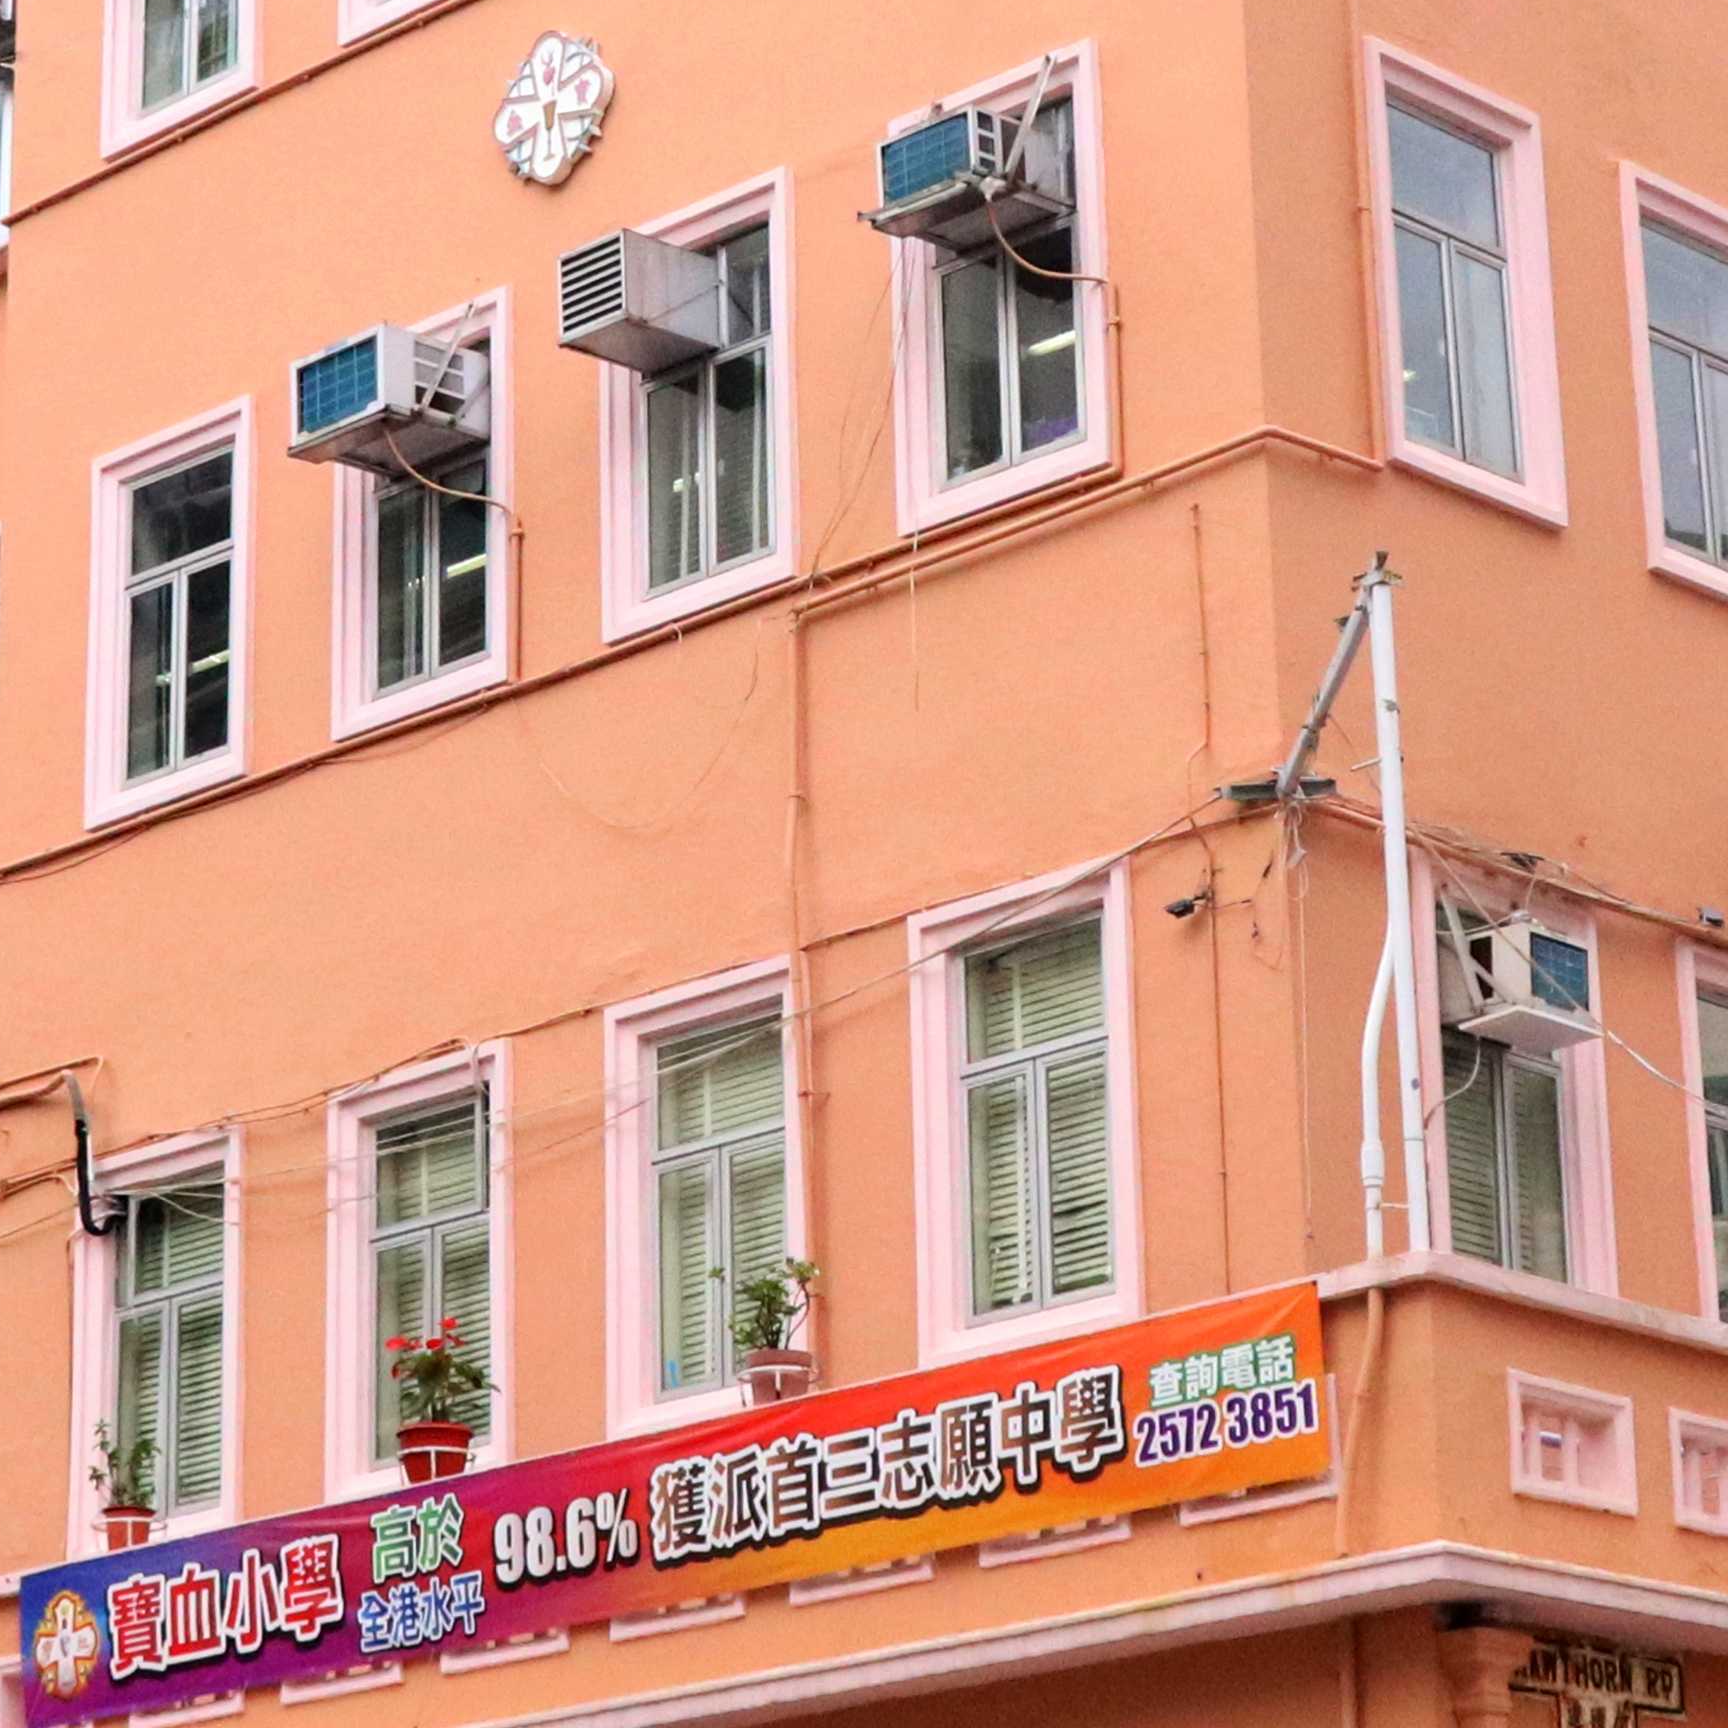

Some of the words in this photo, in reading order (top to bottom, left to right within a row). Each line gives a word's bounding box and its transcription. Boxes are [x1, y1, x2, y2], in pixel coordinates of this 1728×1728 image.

[1149, 1334, 1296, 1408] 查詢電話
[1136, 1403, 1220, 1463] 2572
[1225, 1382, 1316, 1444] 3851
[493, 1487, 639, 1585] 98.6%
[653, 1367, 1122, 1558] 獲派首三志願中學
[370, 1493, 465, 1584] 高於
[107, 1536, 343, 1676] 寶血小學
[358, 1570, 485, 1654] 全港水平
